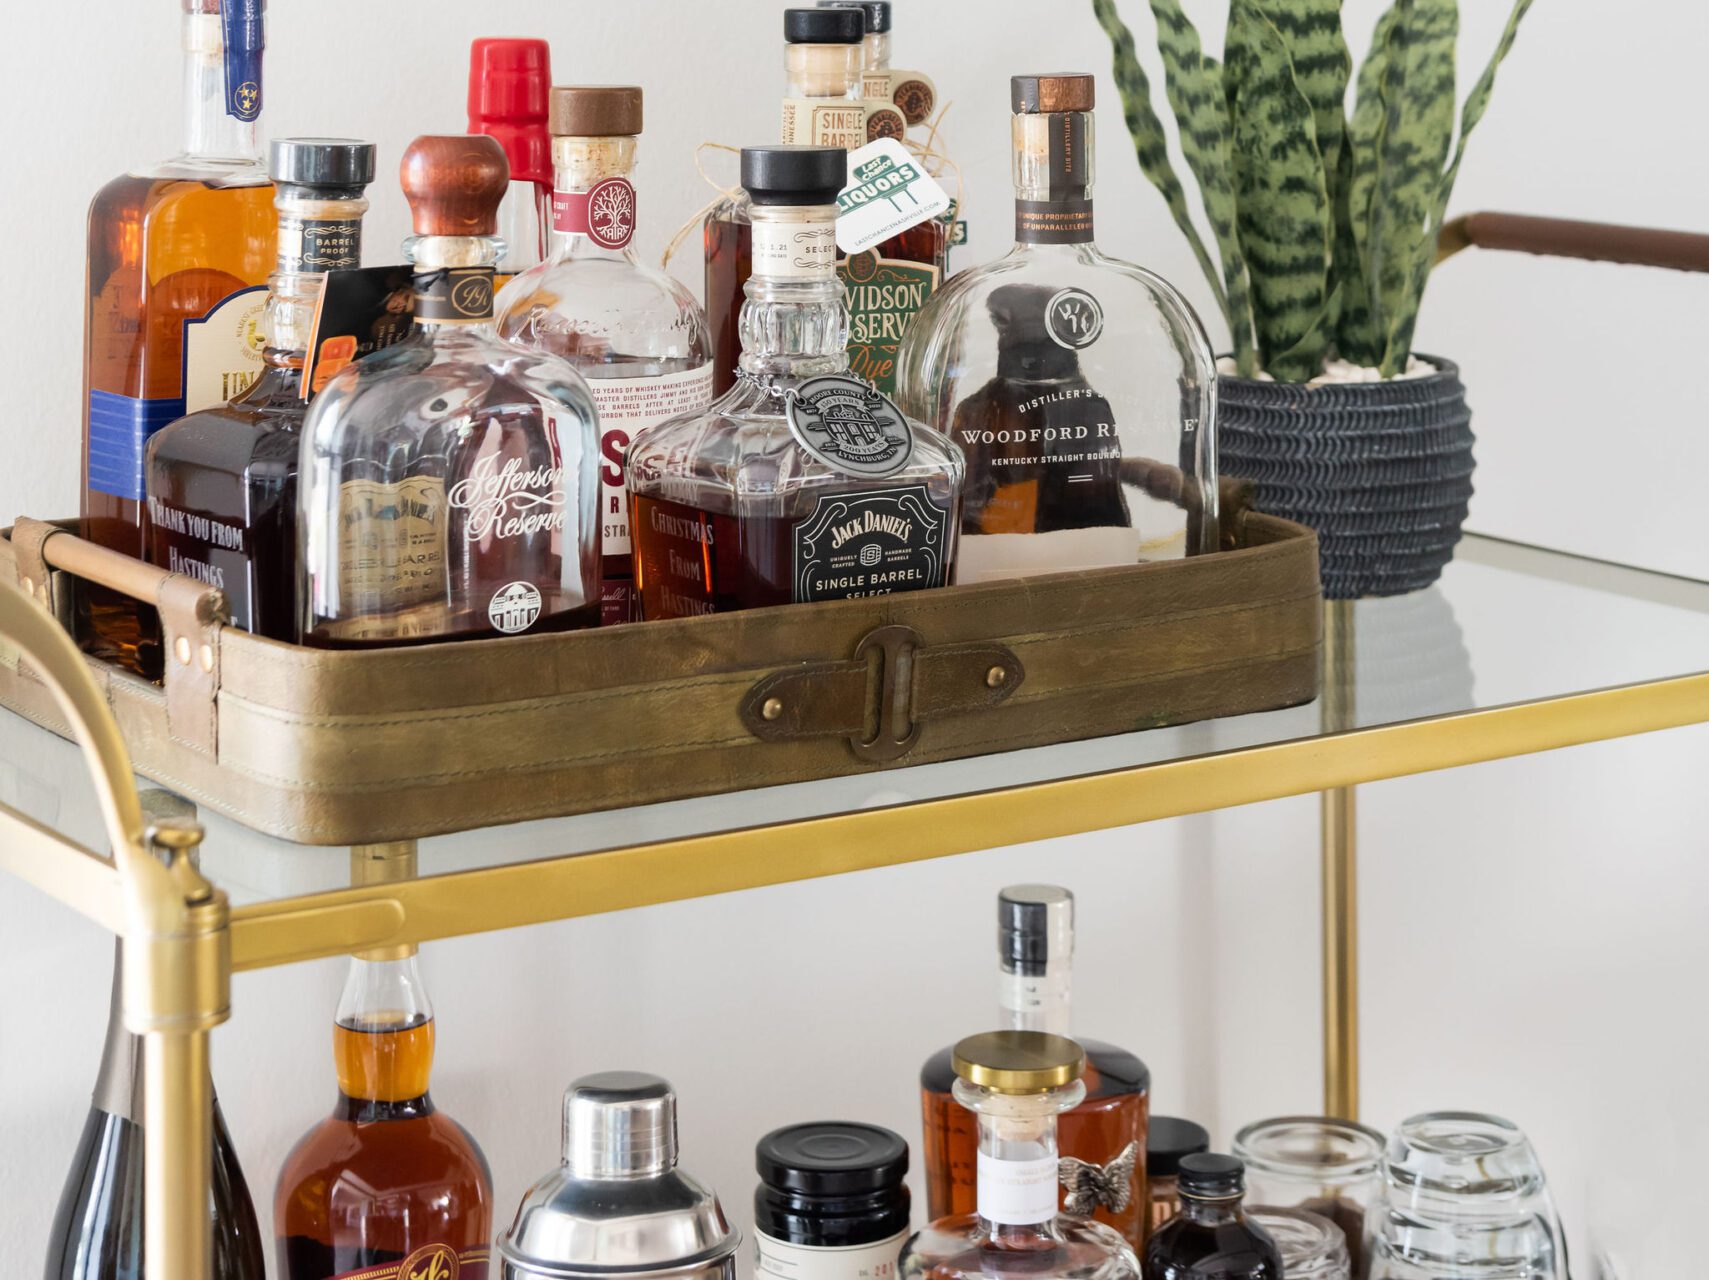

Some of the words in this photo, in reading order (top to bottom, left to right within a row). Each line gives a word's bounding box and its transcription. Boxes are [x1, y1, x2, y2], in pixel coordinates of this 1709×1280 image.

[863, 82, 889, 98] NGLE
[822, 112, 863, 130] SINGLE
[821, 132, 863, 149] BARREL
[838, 165, 915, 212] LIQUORS
[316, 238, 354, 247] BARREL
[320, 247, 349, 255] PROOF
[844, 281, 927, 311] VIDSON
[847, 311, 918, 344] SERV
[623, 393, 658, 402] DISTILLERS
[660, 391, 678, 399] JIMMY
[625, 386, 633, 394] OF
[635, 385, 661, 393] WHISKEY
[662, 382, 682, 391] MAKING
[809, 389, 834, 404] MOORE
[833, 389, 867, 400] COUNTY
[612, 403, 640, 411] BARRELS
[645, 401, 663, 409] AFTER
[833, 396, 860, 406] YEARS
[1018, 389, 1093, 414] DISTILLER'S
[598, 411, 623, 419] URBON
[626, 410, 641, 418] THAT
[645, 408, 671, 417] DELIVERS
[961, 424, 1089, 445] WOODFORD
[991, 456, 1038, 466] KENTUCKY
[1040, 453, 1085, 464] STRAIGHT
[1087, 451, 1121, 461] BOURBO
[148, 495, 187, 535] THANK
[186, 513, 210, 541] YOU
[211, 520, 244, 552] FROM
[467, 497, 568, 542] Reserve
[650, 506, 714, 545] CHRISTMAS
[831, 516, 863, 549] JACK
[864, 510, 913, 542] DANIEL'S
[168, 545, 224, 589] HASTINGS
[669, 548, 701, 582] FROM
[830, 554, 858, 562] UNIQUELY
[831, 561, 855, 569] CRAFTED
[815, 575, 865, 591] SINGLE
[870, 568, 923, 585] BARREL
[660, 585, 716, 616] HASTINGS
